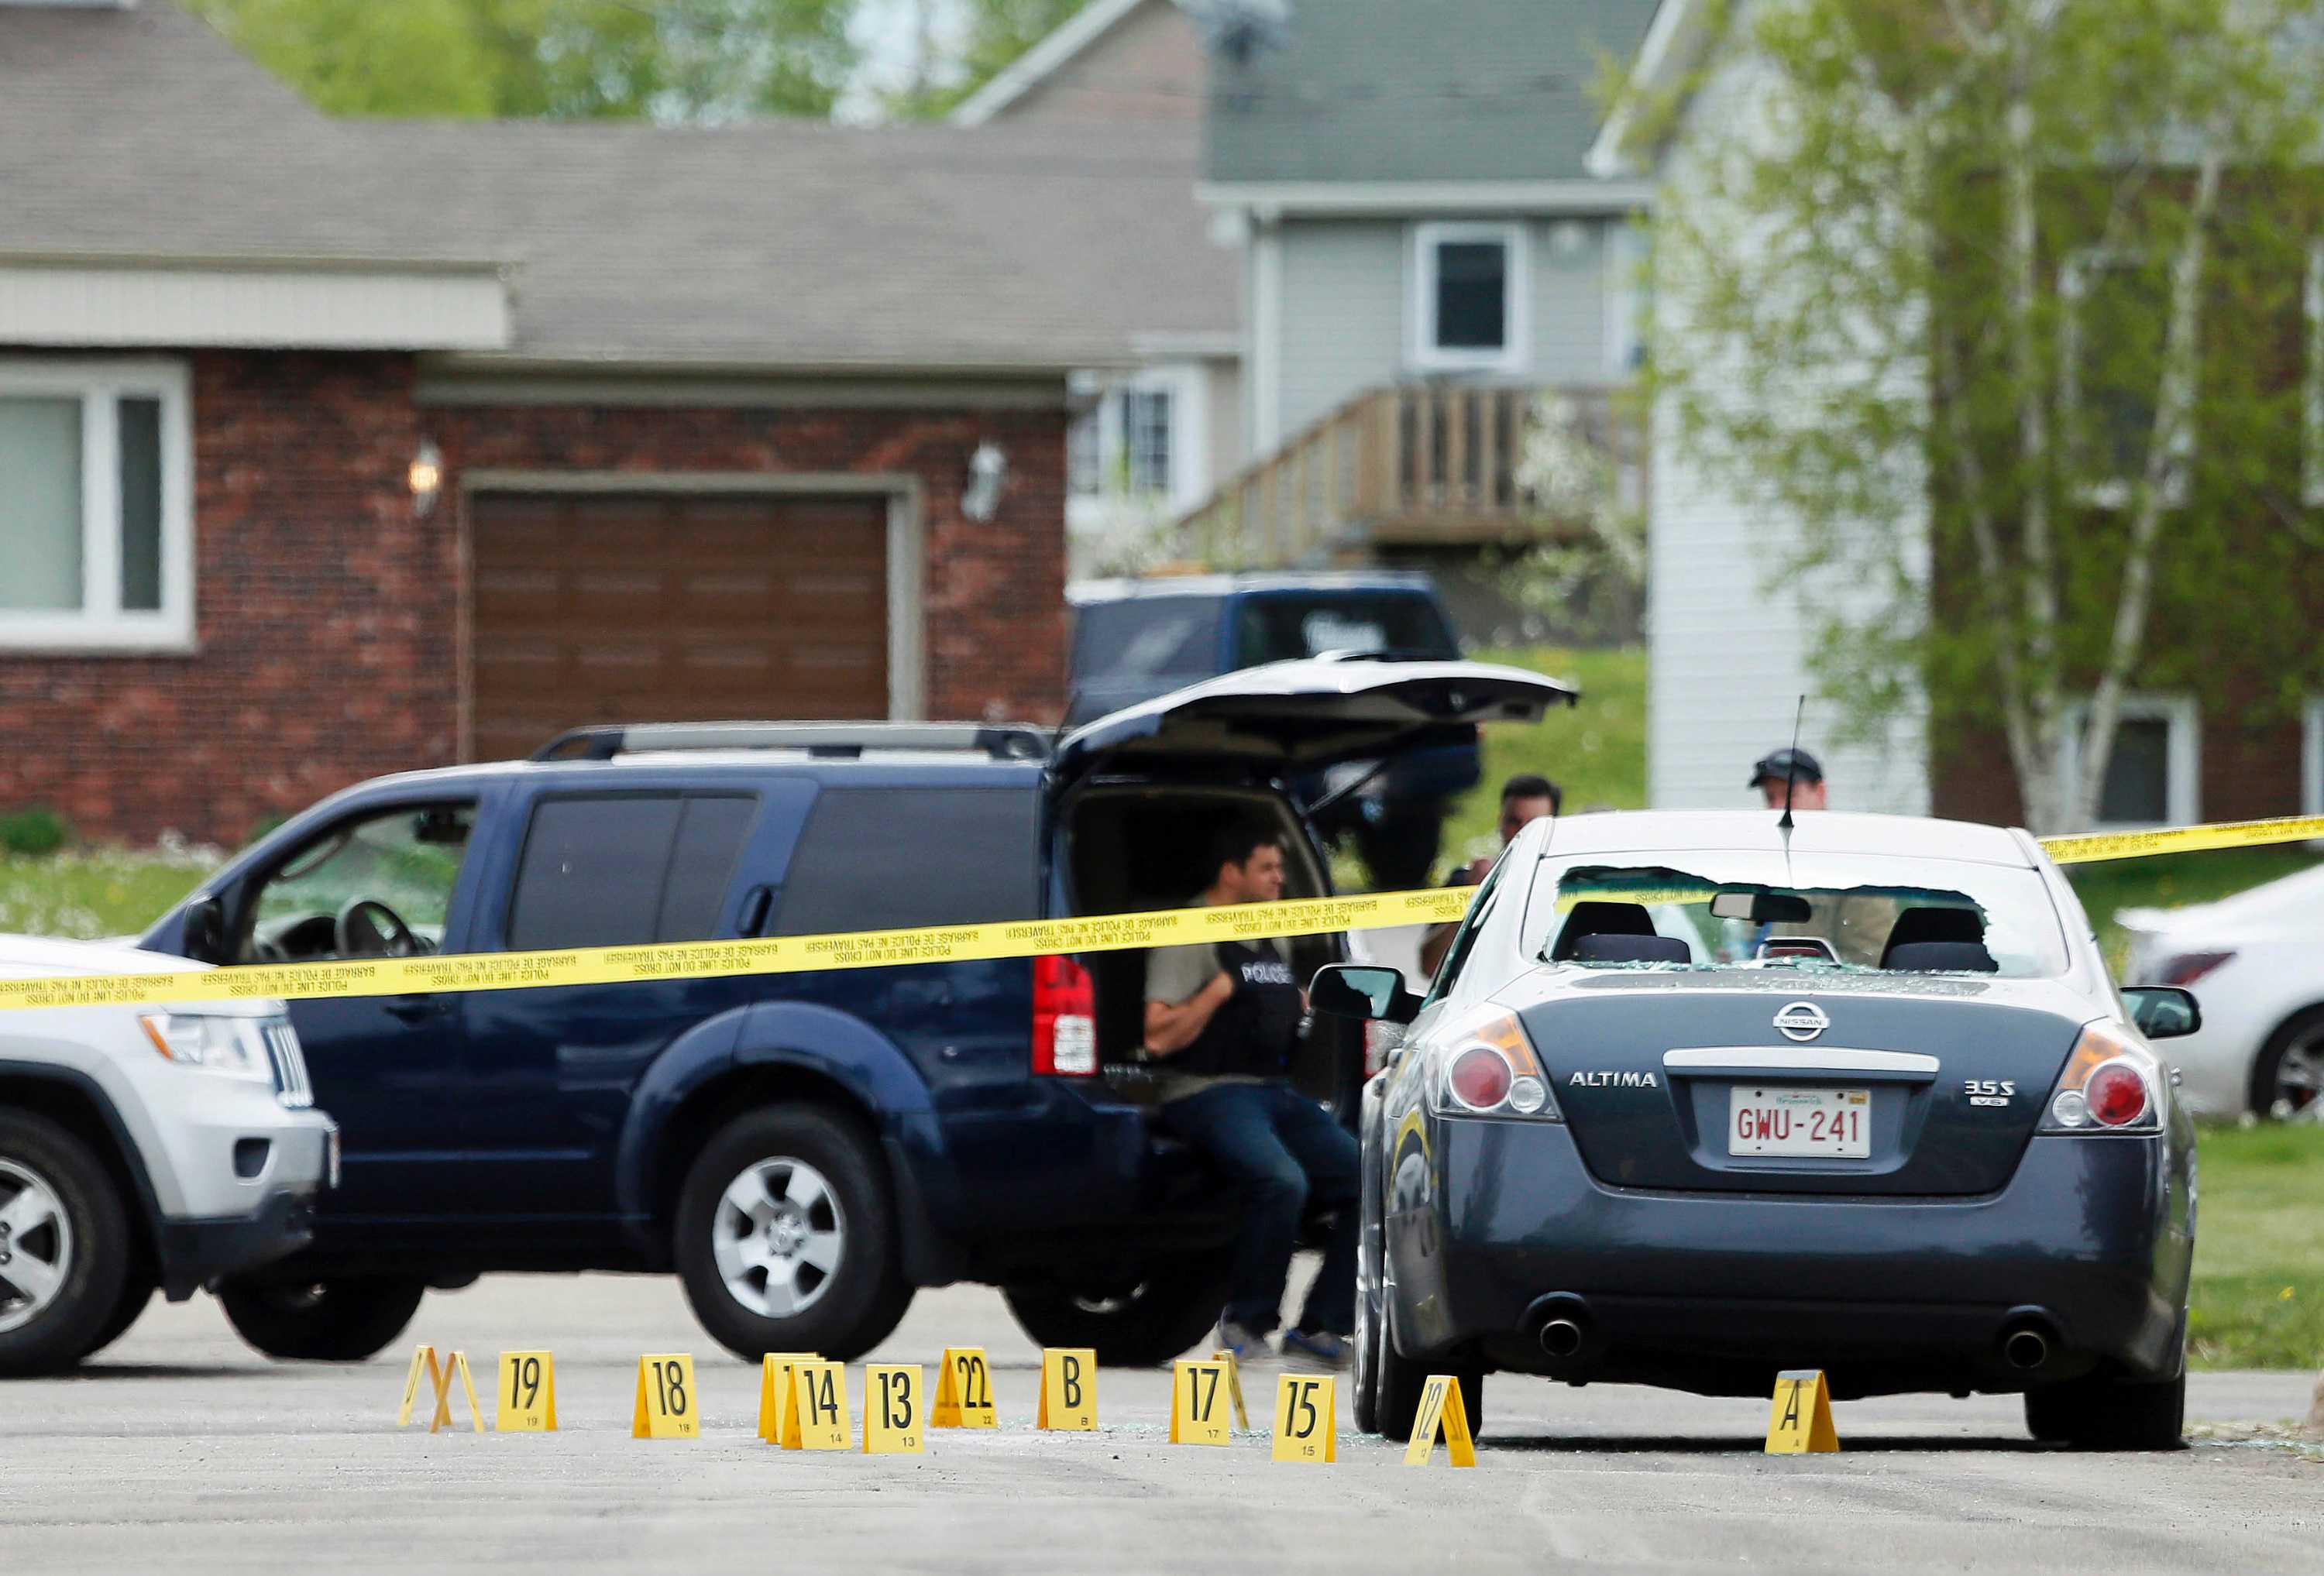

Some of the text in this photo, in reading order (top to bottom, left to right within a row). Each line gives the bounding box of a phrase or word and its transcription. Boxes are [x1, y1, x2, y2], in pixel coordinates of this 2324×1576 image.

[1569, 1071, 1657, 1088] ALTIMA
[1738, 1108, 1858, 1142] GWU-241
[511, 1357, 540, 1410] 19
[652, 1361, 686, 1416] 18
[803, 1369, 838, 1426] 14
[878, 1372, 912, 1430] 13
[957, 1356, 992, 1408] 22
[1062, 1356, 1081, 1409] B
[1187, 1368, 1220, 1423] 17
[1779, 1379, 1800, 1431] A
[527, 1416, 538, 1427] 19
[1208, 1429, 1219, 1438] 17
[1284, 1381, 1319, 1439] 15
[1416, 1382, 1442, 1440] 12
[830, 1433, 843, 1444] 14
[902, 1437, 915, 1447] 13
[1302, 1446, 1315, 1457] 15
